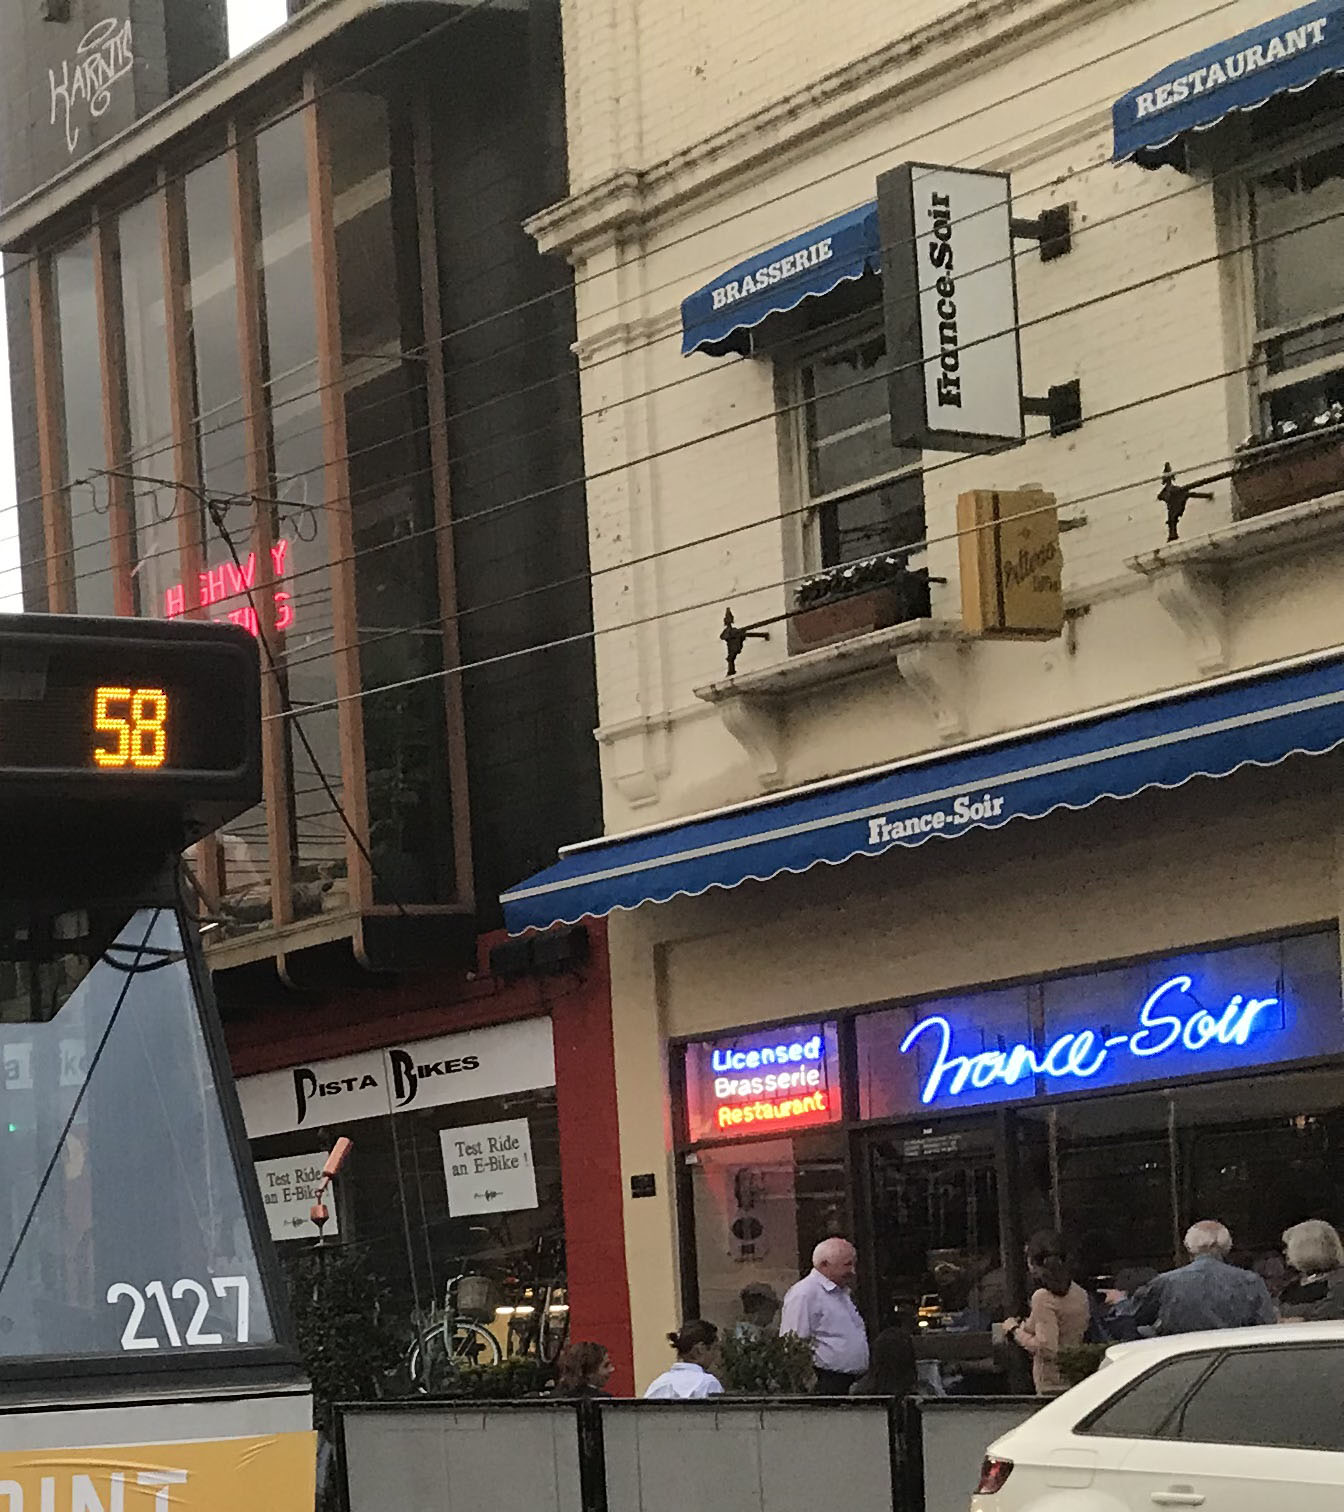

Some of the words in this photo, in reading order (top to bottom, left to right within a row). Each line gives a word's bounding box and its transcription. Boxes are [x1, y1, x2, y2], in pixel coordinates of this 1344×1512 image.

[1135, 17, 1327, 119] RESTAURANT
[711, 237, 834, 311] BRASSERIE
[928, 191, 963, 409] France-Soir
[94, 686, 168, 769] 58
[868, 793, 1005, 845] France-Soir
[712, 1035, 822, 1072] Licensed
[899, 975, 1279, 1104] France-Soir
[292, 1067, 379, 1125] PISTA
[389, 1049, 481, 1108] BIKES
[714, 1064, 820, 1099] Brasserie
[717, 1090, 827, 1128] Restaurant
[452, 1163, 469, 1177] an
[473, 1154, 520, 1174] E-Bike
[454, 1141, 483, 1158] Test
[487, 1135, 520, 1153] Ride
[263, 1193, 279, 1205] an
[282, 1184, 319, 1203] E-Bik
[265, 1172, 291, 1187] Test
[294, 1166, 321, 1184] Ride
[107, 1275, 250, 1350] 2127
